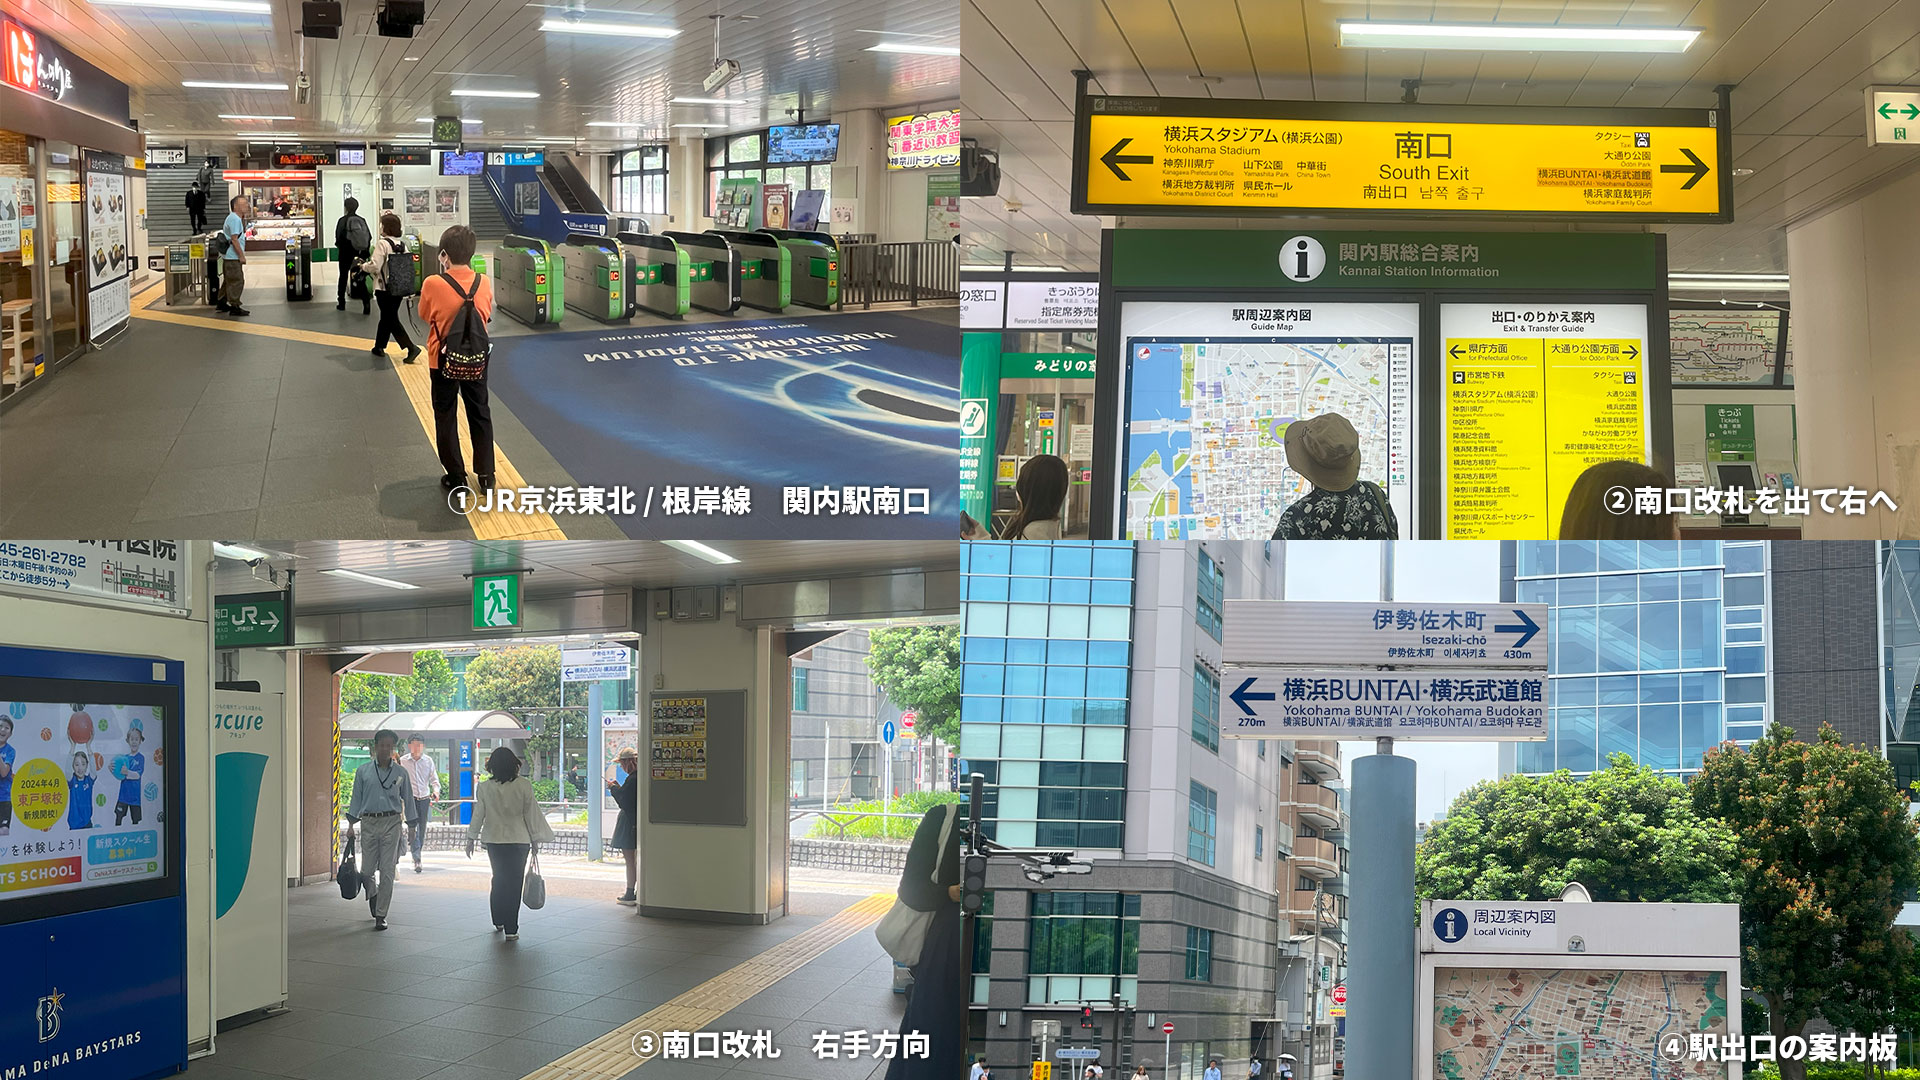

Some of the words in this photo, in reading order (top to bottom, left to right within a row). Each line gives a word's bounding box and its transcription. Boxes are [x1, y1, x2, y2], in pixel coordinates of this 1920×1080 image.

[1595, 131, 1631, 141] タクシー
[1164, 145, 1217, 155] Yokohama
[1220, 145, 1261, 155] Stadium
[1395, 131, 1452, 159] 南口
[890, 154, 960, 166] 神奈川ドライビン
[1604, 151, 1652, 161] 大通り公園
[1163, 158, 1215, 169] 神奈川県庁
[1243, 159, 1283, 170] 山下公園
[1296, 161, 1327, 172] 中華街
[1379, 164, 1430, 180] South
[1438, 165, 1470, 181] Exit
[1162, 179, 1235, 190] 横浜地方裁判所
[1243, 181, 1293, 192] 県民ホール
[1363, 184, 1407, 200] 南出口
[1420, 186, 1448, 200] 남쪽
[1456, 186, 1485, 200] 출구
[1583, 188, 1652, 199] 横浜家庭裁判所
[1339, 243, 1479, 262] 関内駅総合案内
[1339, 265, 1381, 276] Kannai
[1384, 265, 1427, 276] Station
[1431, 266, 1499, 277] Information
[1232, 309, 1312, 321] 駅周辺案内図
[1492, 311, 1595, 323] 出口・のりかえ案内
[1251, 323, 1275, 331] Guide
[1277, 323, 1294, 332] Map
[1562, 325, 1585, 333] Guide
[1468, 343, 1508, 354] 県庁方面
[1551, 344, 1620, 354] 大通り公園方面
[1593, 371, 1622, 379] タクシー
[1718, 408, 1742, 417] きっぷ
[0, 570, 57, 587] こから徒歩5分
[232, 606, 258, 626] JR
[1372, 609, 1487, 631] 伊勢佐木町
[1421, 634, 1487, 646] Isezaki-chō
[1503, 650, 1532, 659] 430m
[1283, 705, 1350, 716] Yokohama
[1355, 705, 1402, 716] BUNTAI
[1406, 705, 1412, 716] /
[1415, 705, 1482, 716] Yokohama
[1486, 705, 1543, 716] Budokan
[1238, 718, 1266, 728] 270m
[1516, 717, 1543, 728] 무도관
[21, 778, 60, 789] 2024年4月
[18, 791, 63, 807] 東戸塚校
[95, 833, 152, 849] 新規スクール生
[20, 864, 76, 882] SCHOOL
[1473, 909, 1556, 924] 周辺案内図
[1474, 927, 1497, 937] Local
[1498, 927, 1532, 938] Vicinity
[33, 1052, 70, 1073] DeNA
[76, 1031, 141, 1060] BAYSTARS
